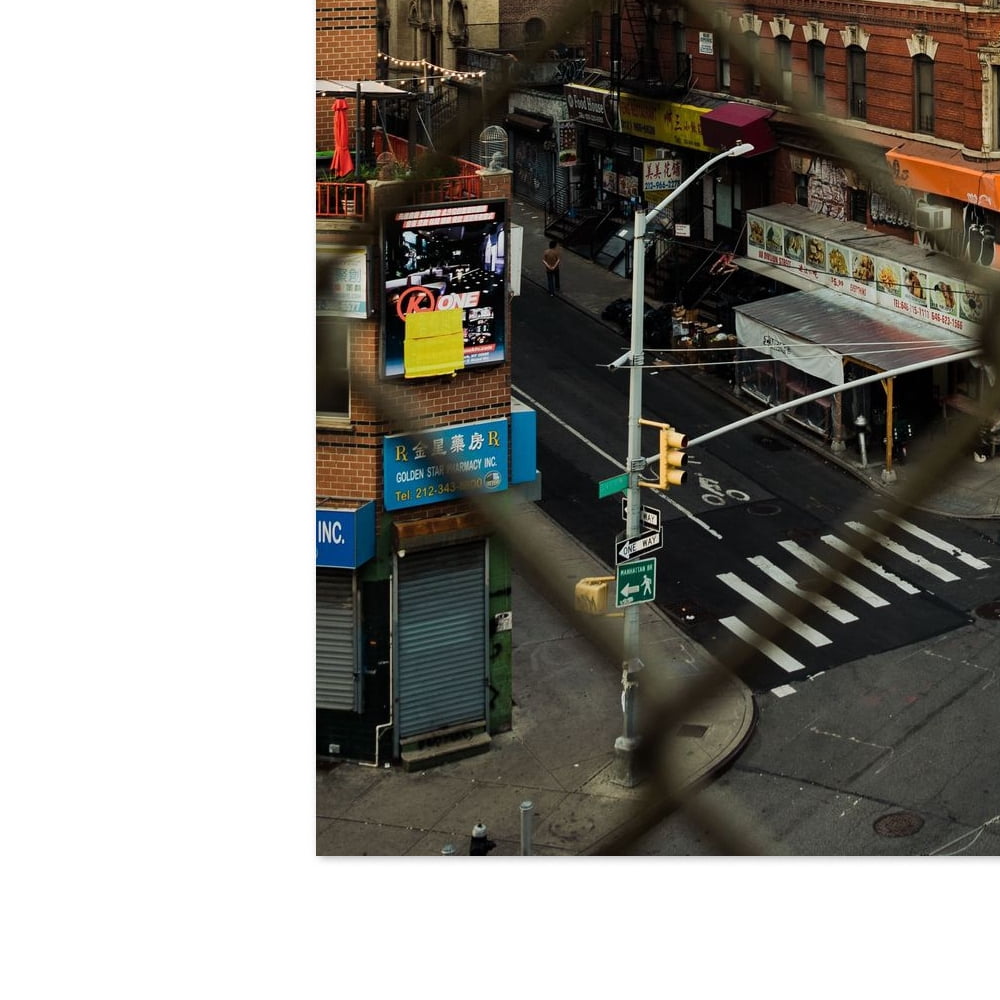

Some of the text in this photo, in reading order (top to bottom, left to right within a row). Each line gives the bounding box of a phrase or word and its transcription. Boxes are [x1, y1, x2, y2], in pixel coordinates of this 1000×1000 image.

[436, 291, 480, 311] ONE
[412, 432, 485, 460] 金星藥房
[396, 469, 424, 483] GOLDEN
[484, 456, 498, 468] INC.
[318, 520, 345, 544] INC.
[623, 535, 656, 555] ONE WAY
[620, 565, 646, 576] MANHATTAN
